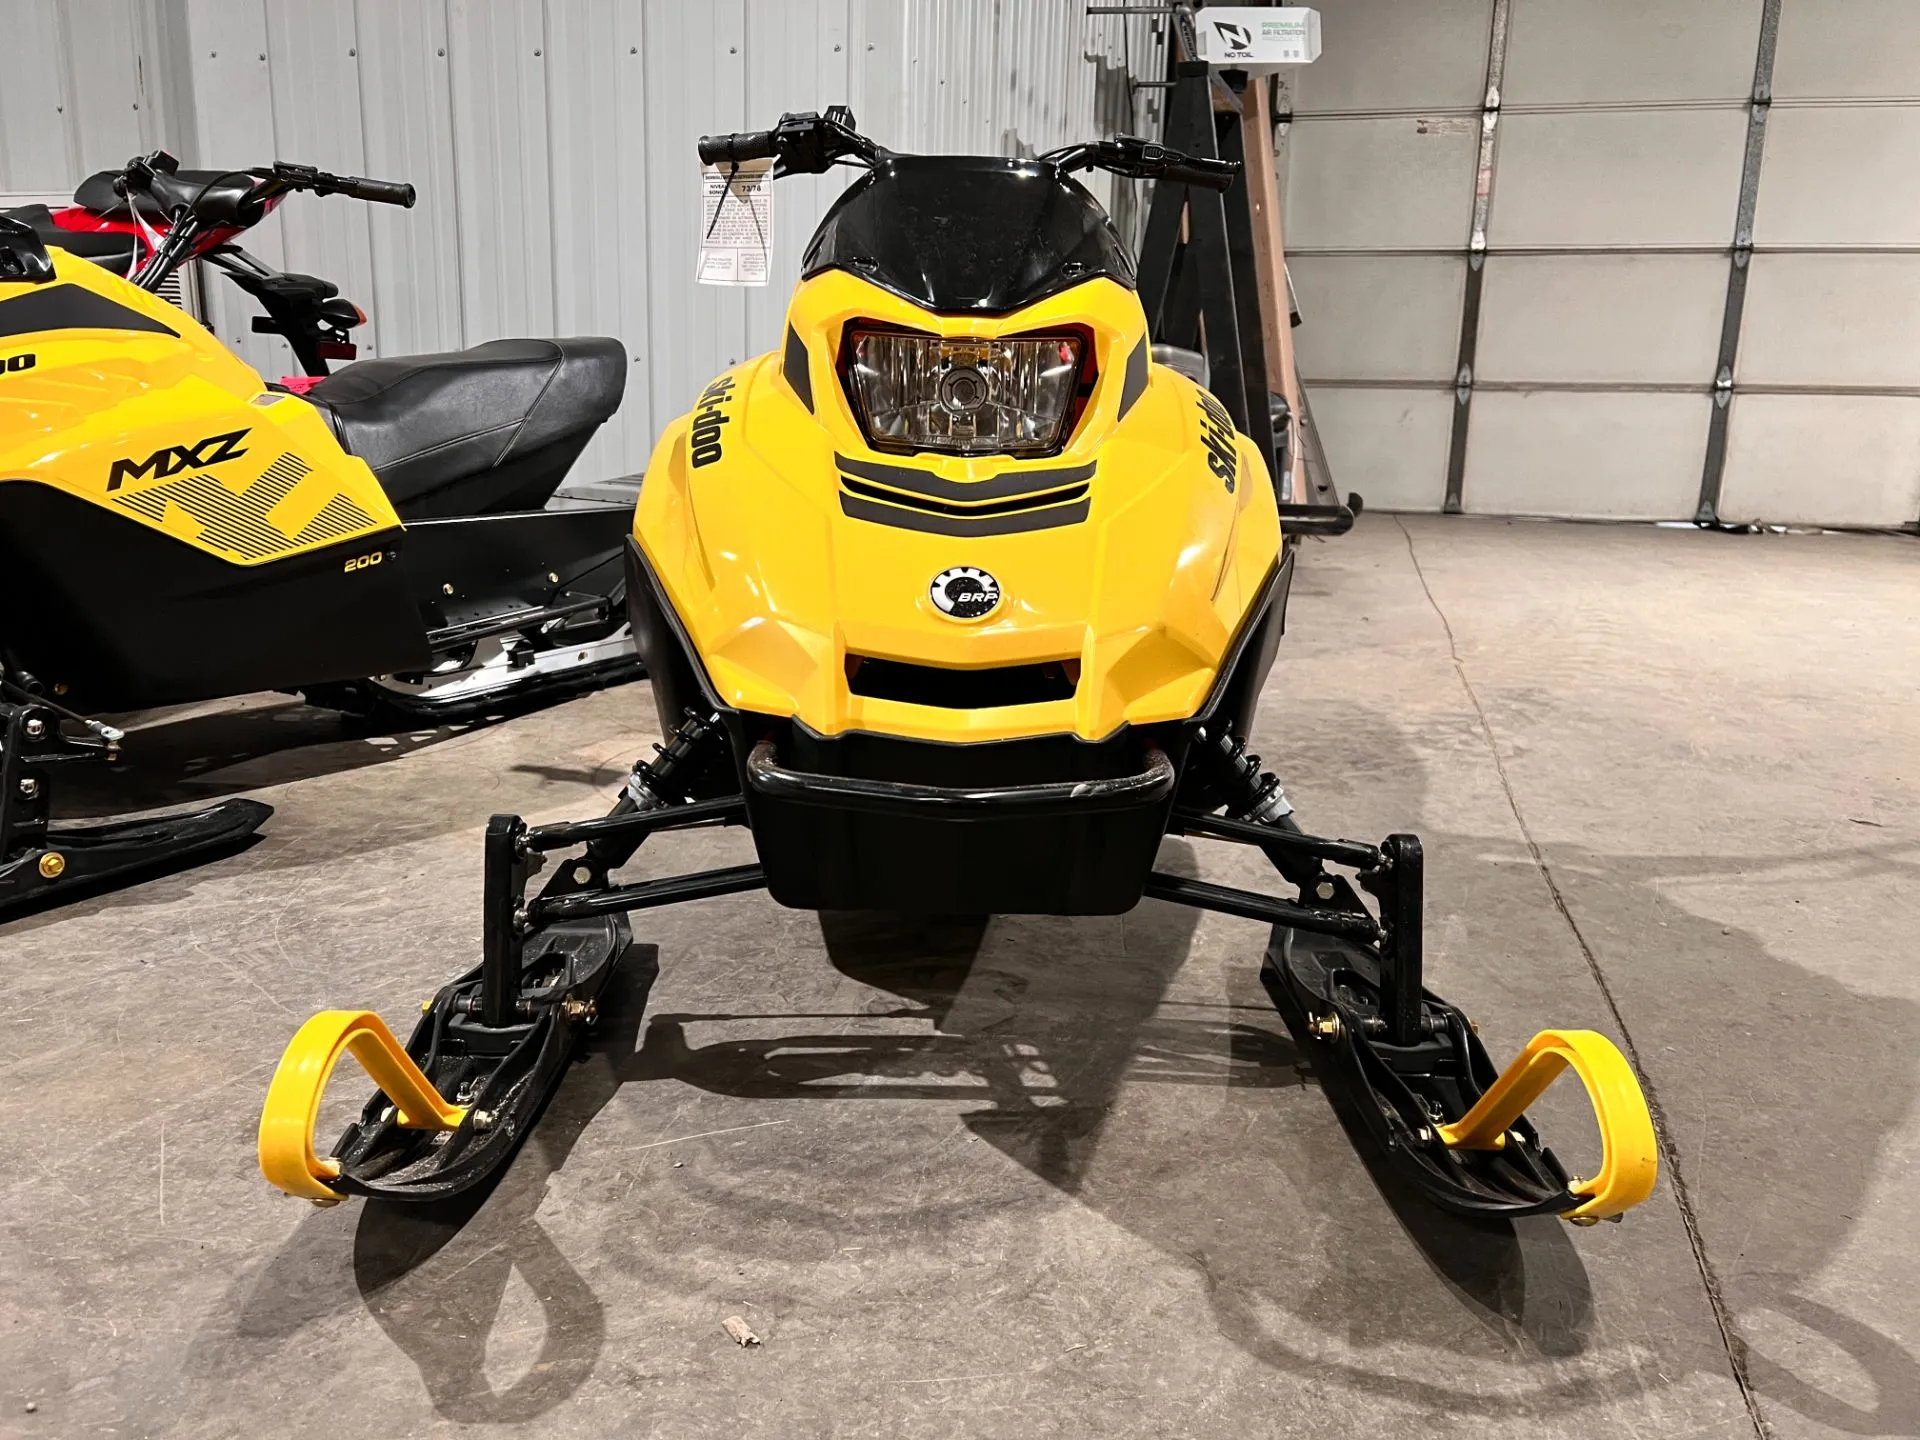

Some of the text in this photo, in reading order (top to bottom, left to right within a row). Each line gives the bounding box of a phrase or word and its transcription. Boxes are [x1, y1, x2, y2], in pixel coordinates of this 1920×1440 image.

[691, 376, 736, 469] ski-doo
[1195, 388, 1237, 494] ski-doo
[106, 427, 253, 492] MXZ
[344, 551, 383, 573] 200
[957, 592, 999, 603] BRP
